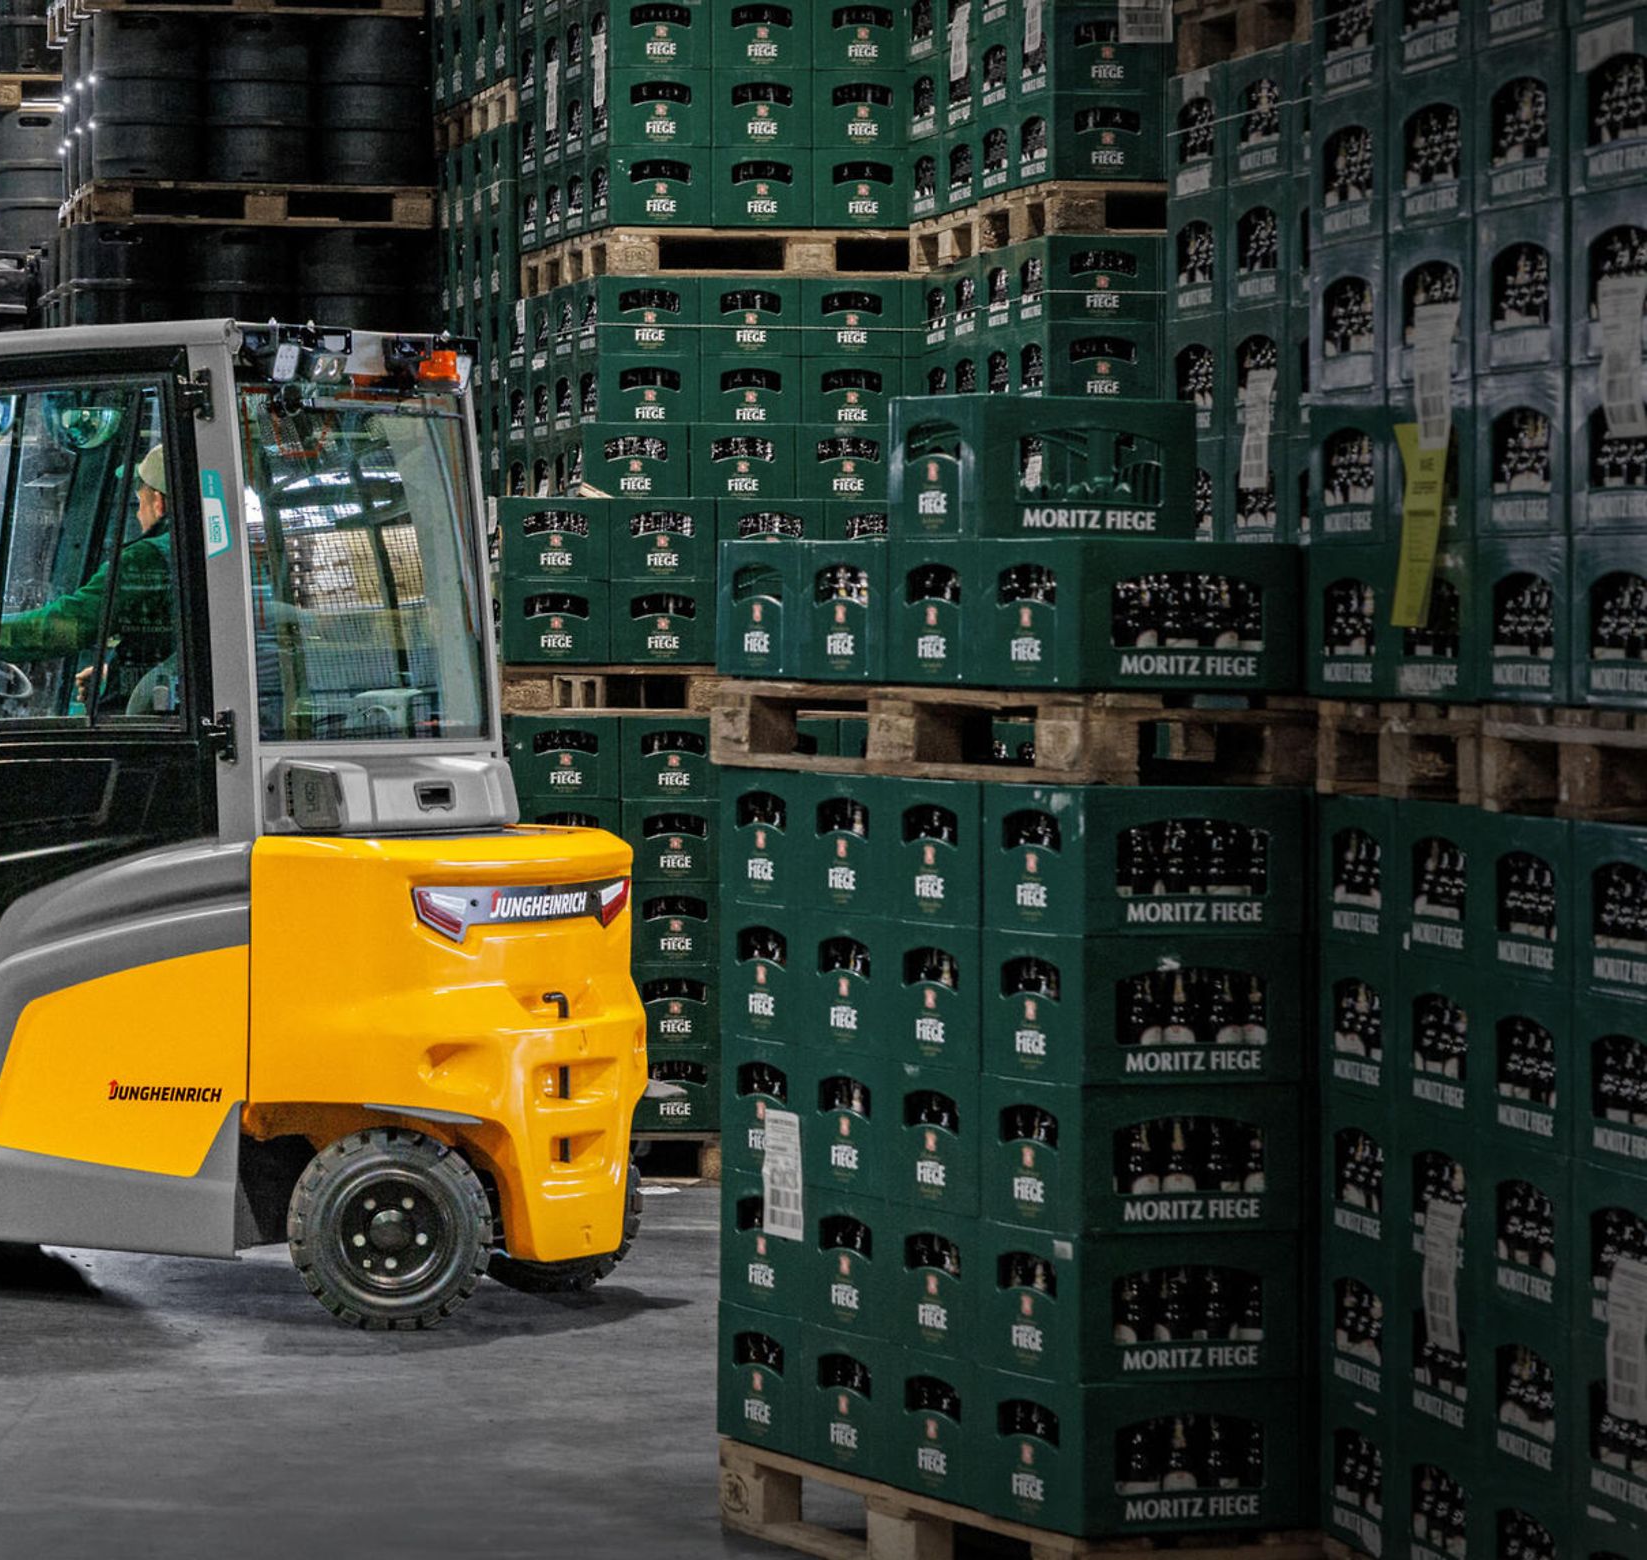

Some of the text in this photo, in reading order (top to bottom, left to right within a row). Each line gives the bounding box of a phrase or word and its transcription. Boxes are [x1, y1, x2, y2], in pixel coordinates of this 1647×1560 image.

[647, 42, 676, 54] FIEGE
[748, 43, 777, 56] FIEGE
[849, 44, 877, 57] FIEGE
[1092, 65, 1123, 78] FIEGE
[646, 121, 675, 133] FIEGE
[748, 122, 777, 134] FIEGE
[848, 123, 877, 135] FIEGE
[1092, 151, 1123, 164] FIEGE
[647, 199, 675, 211] FIEGE
[748, 200, 776, 212] FIEGE
[849, 201, 878, 213] FIEGE
[1087, 295, 1118, 307] FIEGE
[636, 329, 664, 340] FIEGE
[737, 330, 765, 342] FIEGE
[838, 331, 866, 343] FIEGE
[1087, 380, 1118, 393] FIEGE
[636, 406, 664, 418] FIEGE
[737, 408, 765, 420] FIEGE
[838, 409, 867, 420] FIEGE
[621, 477, 651, 490] FIEGE
[728, 478, 758, 491] FIEGE
[834, 478, 863, 490] FIEGE
[919, 491, 946, 514] FIEGE
[1023, 509, 1155, 530] MORITZ FIEGE
[541, 552, 571, 565] FIEGE
[648, 553, 678, 565] FIEGE
[541, 635, 571, 647] FIEGE
[648, 636, 678, 648] FIEGE
[744, 631, 769, 653] FIEGE
[827, 633, 854, 655] FIEGE
[918, 635, 946, 658] FIEGE
[1011, 637, 1041, 661] FIEGE
[1121, 655, 1256, 675] MORITZ FIEGE
[551, 771, 581, 784] FIEGE
[659, 772, 689, 785] FIEGE
[661, 855, 691, 867] FIEGE
[748, 858, 773, 880] FIEGE
[829, 867, 855, 890] FIEGE
[915, 874, 944, 898] FIEGE
[490, 890, 587, 918] JUNGHEINRICH
[1017, 883, 1047, 907] FIEGE
[1128, 902, 1262, 922] MORITZ FIEGE
[661, 937, 691, 950] FIEGE
[749, 993, 774, 1016] FIEGE
[661, 1019, 691, 1032] FIEGE
[831, 1006, 857, 1029] FIEGE
[916, 1018, 944, 1042] FIEGE
[1016, 1030, 1045, 1055] FIEGE
[1126, 1051, 1260, 1072] MORITZ FIEGE
[108, 1080, 223, 1102] JUNGHEINRICH
[660, 1102, 690, 1115] FIEGE
[831, 1145, 858, 1169] FIEGE
[917, 1161, 945, 1186] FIEGE
[1014, 1177, 1044, 1202] FIEGE
[1124, 1199, 1259, 1221] MORITZ FIEGE
[749, 1263, 774, 1288] FIEGE
[832, 1284, 858, 1309] FIEGE
[919, 1304, 947, 1329] FIEGE
[1012, 1325, 1042, 1351] FIEGE
[1124, 1346, 1257, 1370] MORITZ FIEGE
[745, 1399, 770, 1424] FIEGE
[830, 1423, 857, 1448] FIEGE
[918, 1448, 946, 1474] FIEGE
[1012, 1473, 1044, 1500] FIEGE
[1126, 1495, 1258, 1520] MORITZ FIEGE
